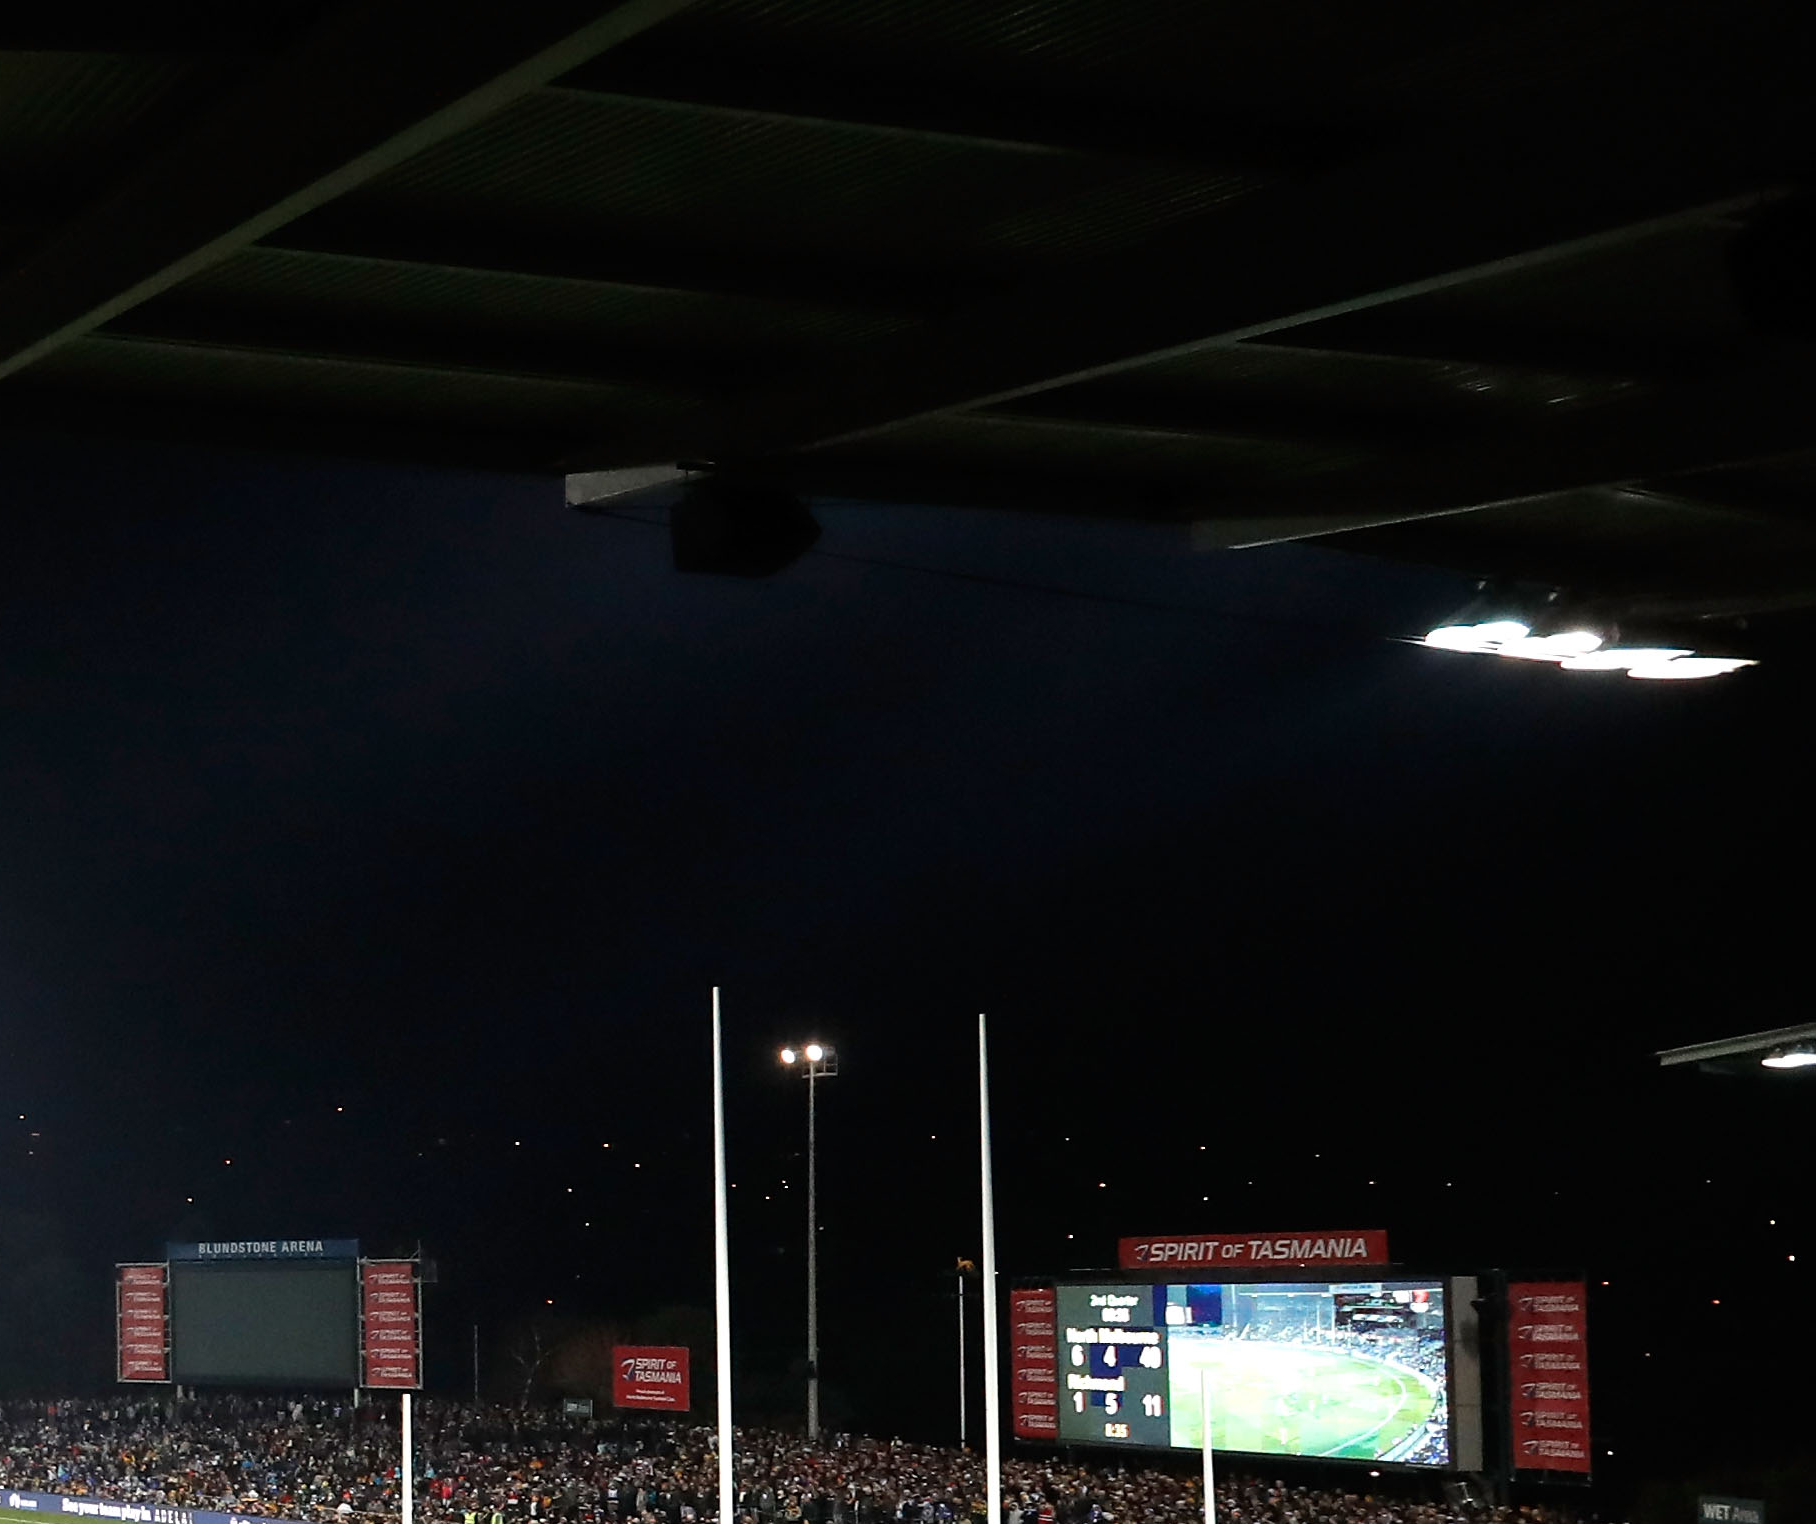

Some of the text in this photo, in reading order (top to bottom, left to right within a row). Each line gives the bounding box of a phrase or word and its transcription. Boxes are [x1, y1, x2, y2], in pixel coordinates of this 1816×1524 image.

[198, 1240, 324, 1254] BLUNDSTONE ARENA
[1149, 1238, 1368, 1262] SPIRIT OF TASMANIA
[635, 1357, 667, 1370] SPIRIT
[1103, 1345, 1118, 1368] 4
[635, 1370, 682, 1384] TASMANIA
[1073, 1391, 1164, 1417] 1 5 11
[1702, 1502, 1731, 1520] WET
